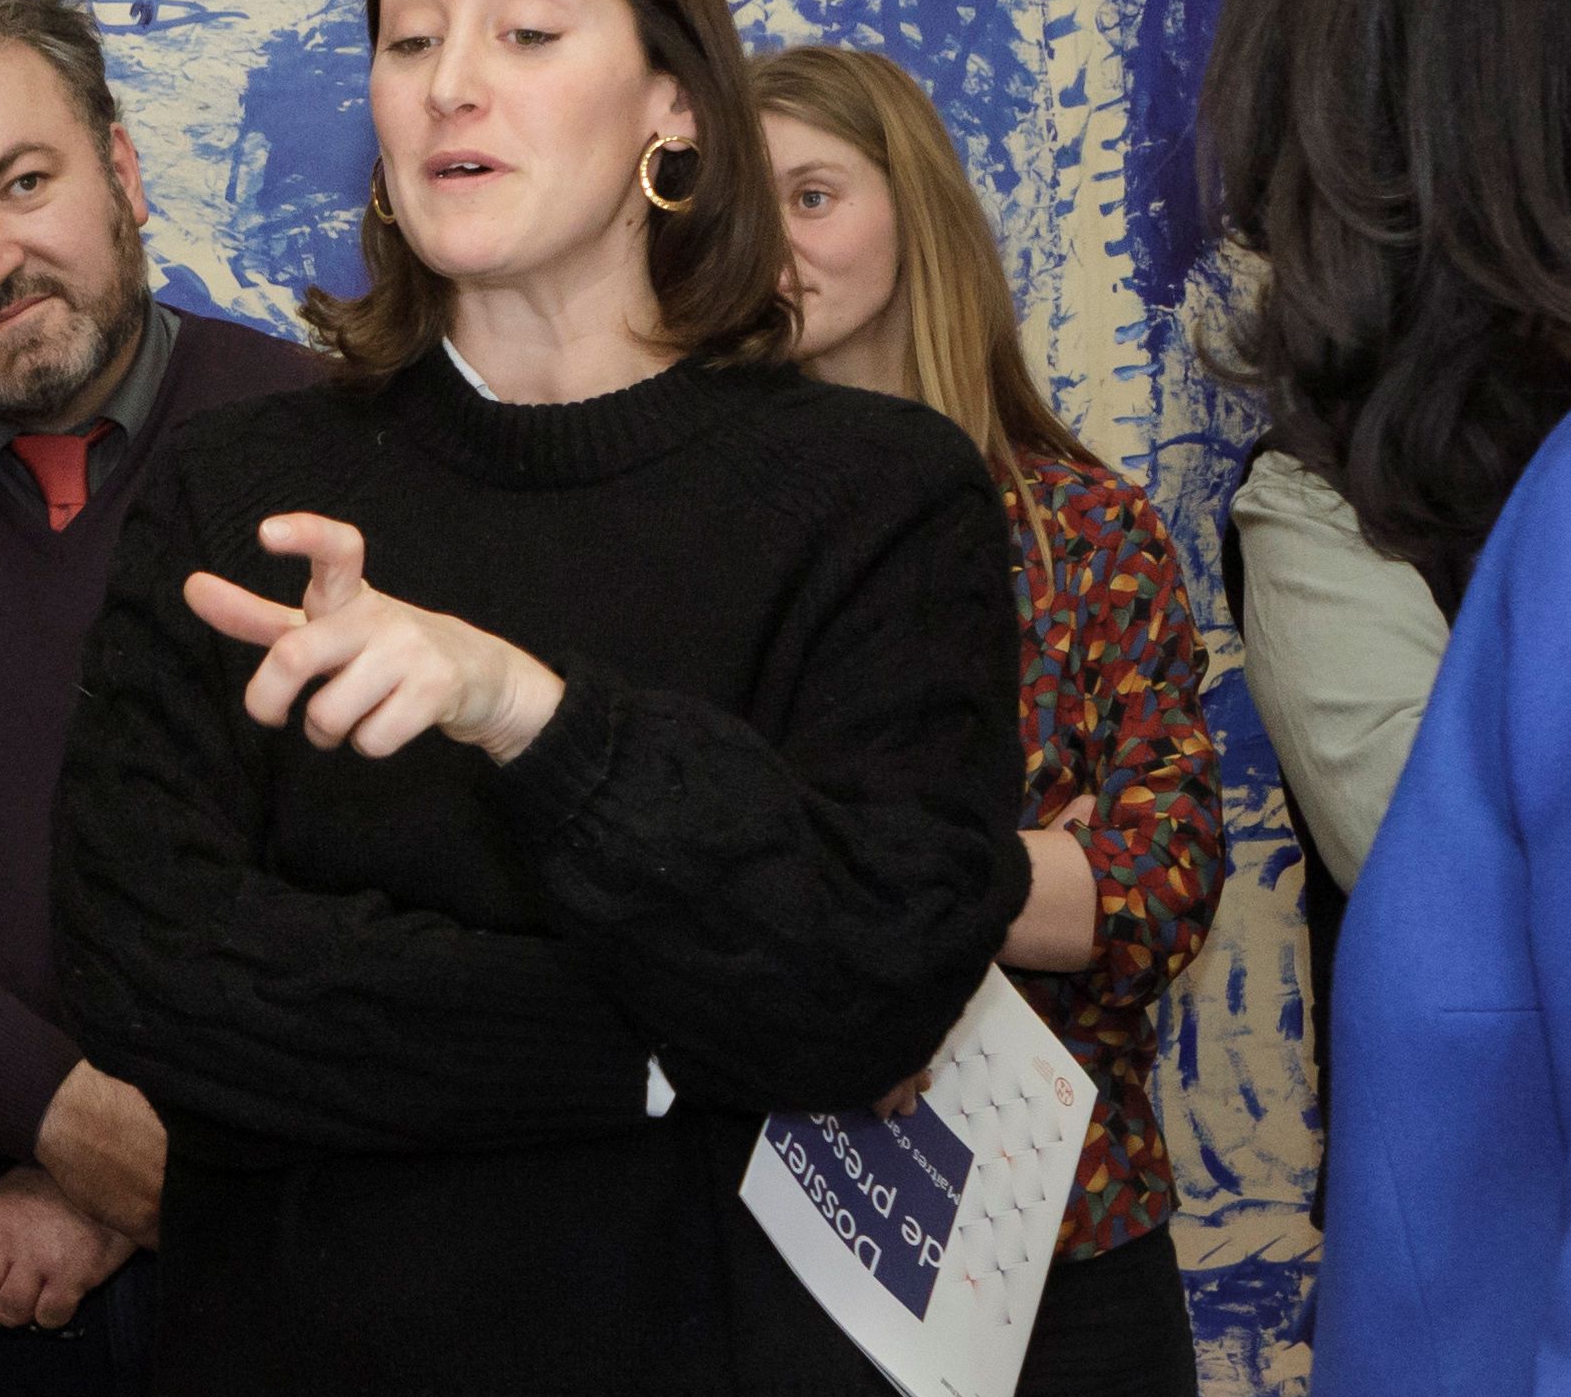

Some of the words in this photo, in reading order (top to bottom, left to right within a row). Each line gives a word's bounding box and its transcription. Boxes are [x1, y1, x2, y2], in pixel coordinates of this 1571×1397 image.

[774, 1131, 883, 1277] Dossier
[911, 1148, 961, 1206] Maîtres
[900, 1215, 946, 1269] de
